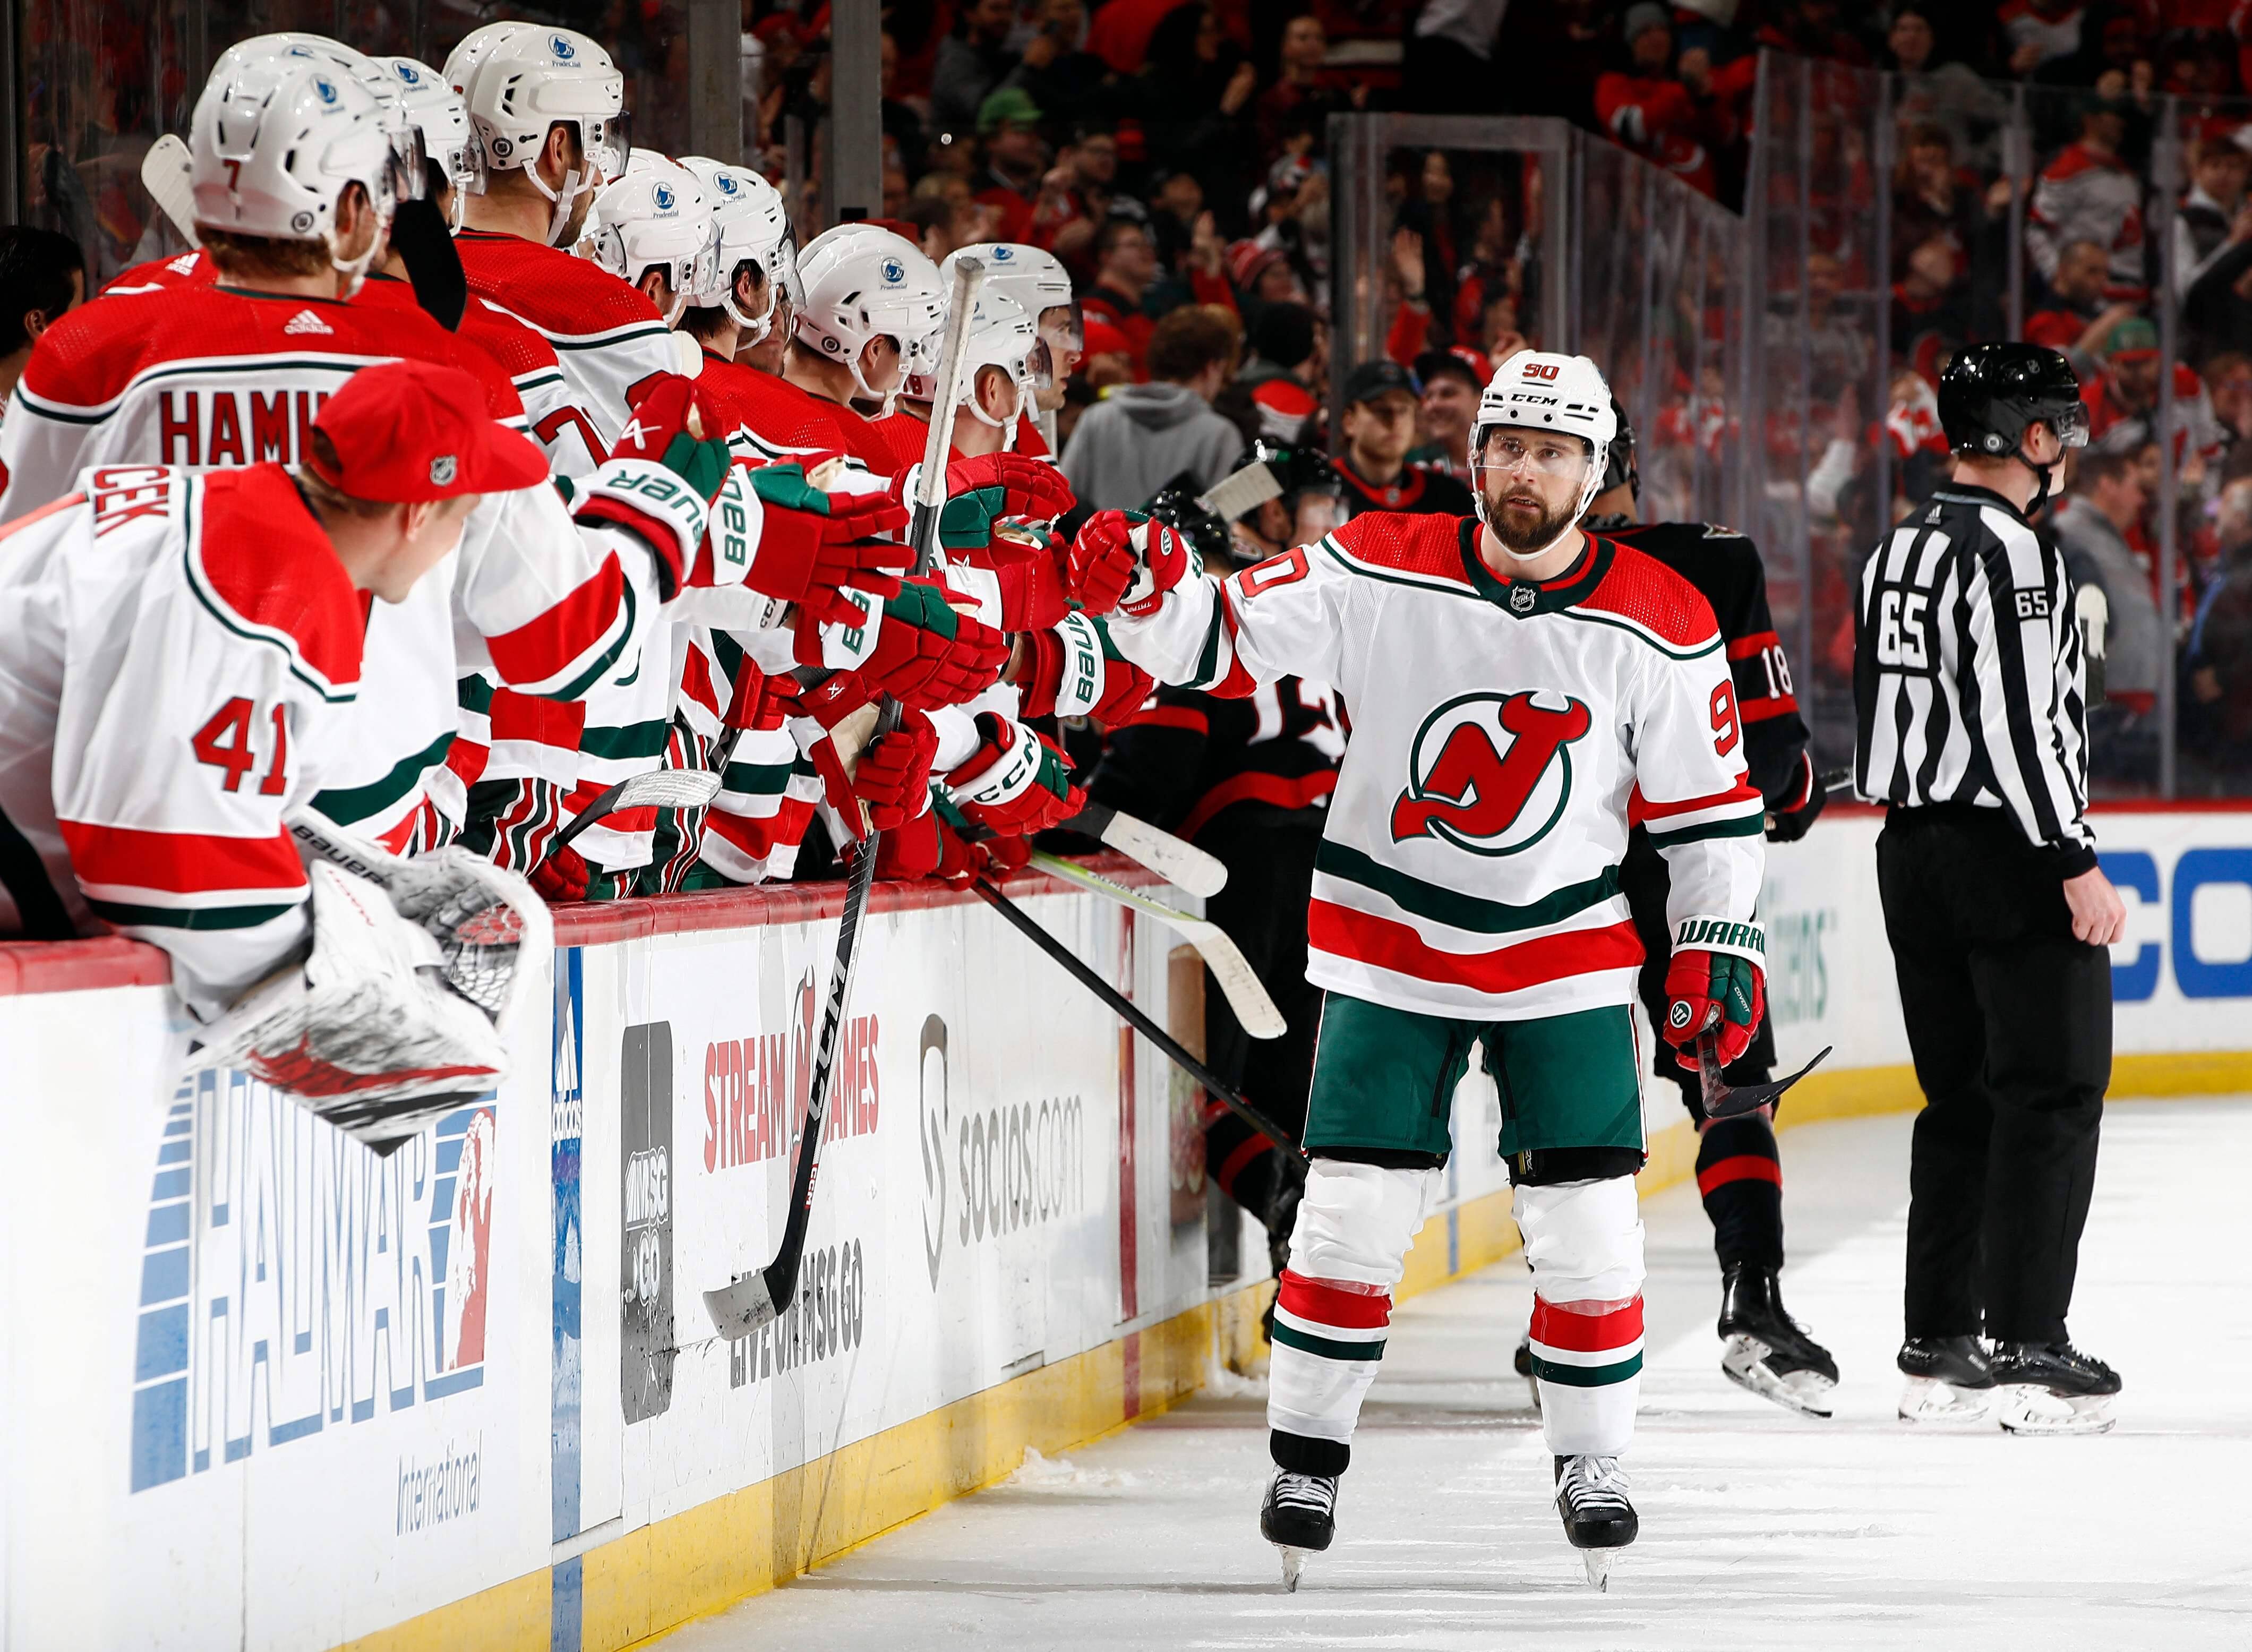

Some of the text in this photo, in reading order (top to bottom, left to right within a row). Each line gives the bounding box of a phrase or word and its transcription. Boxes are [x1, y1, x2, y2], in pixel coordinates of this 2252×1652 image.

[222, 159, 241, 192] 7
[653, 210, 679, 219] Prudential
[1511, 393, 1559, 406] CCM
[1522, 363, 1560, 381] 90
[160, 391, 328, 466] HAMI
[760, 598, 777, 629] CC
[1878, 589, 1929, 669] 65
[2015, 589, 2049, 619] 65
[1761, 645, 1794, 700] 18
[191, 696, 287, 797] 41
[971, 727, 1037, 802] CCM
[1734, 986, 1751, 1013] COVERT
[808, 955, 846, 1122] CCM
[552, 1089, 582, 1143] adidas
[704, 1032, 786, 1175] STREAM
[821, 1013, 879, 1146] AMES
[805, 1167, 819, 1206] CCM
[959, 1094, 1084, 1248] socios.com
[802, 1245, 837, 1365] MSG
[841, 1237, 863, 1353] GO
[396, 1428, 483, 1537] International
